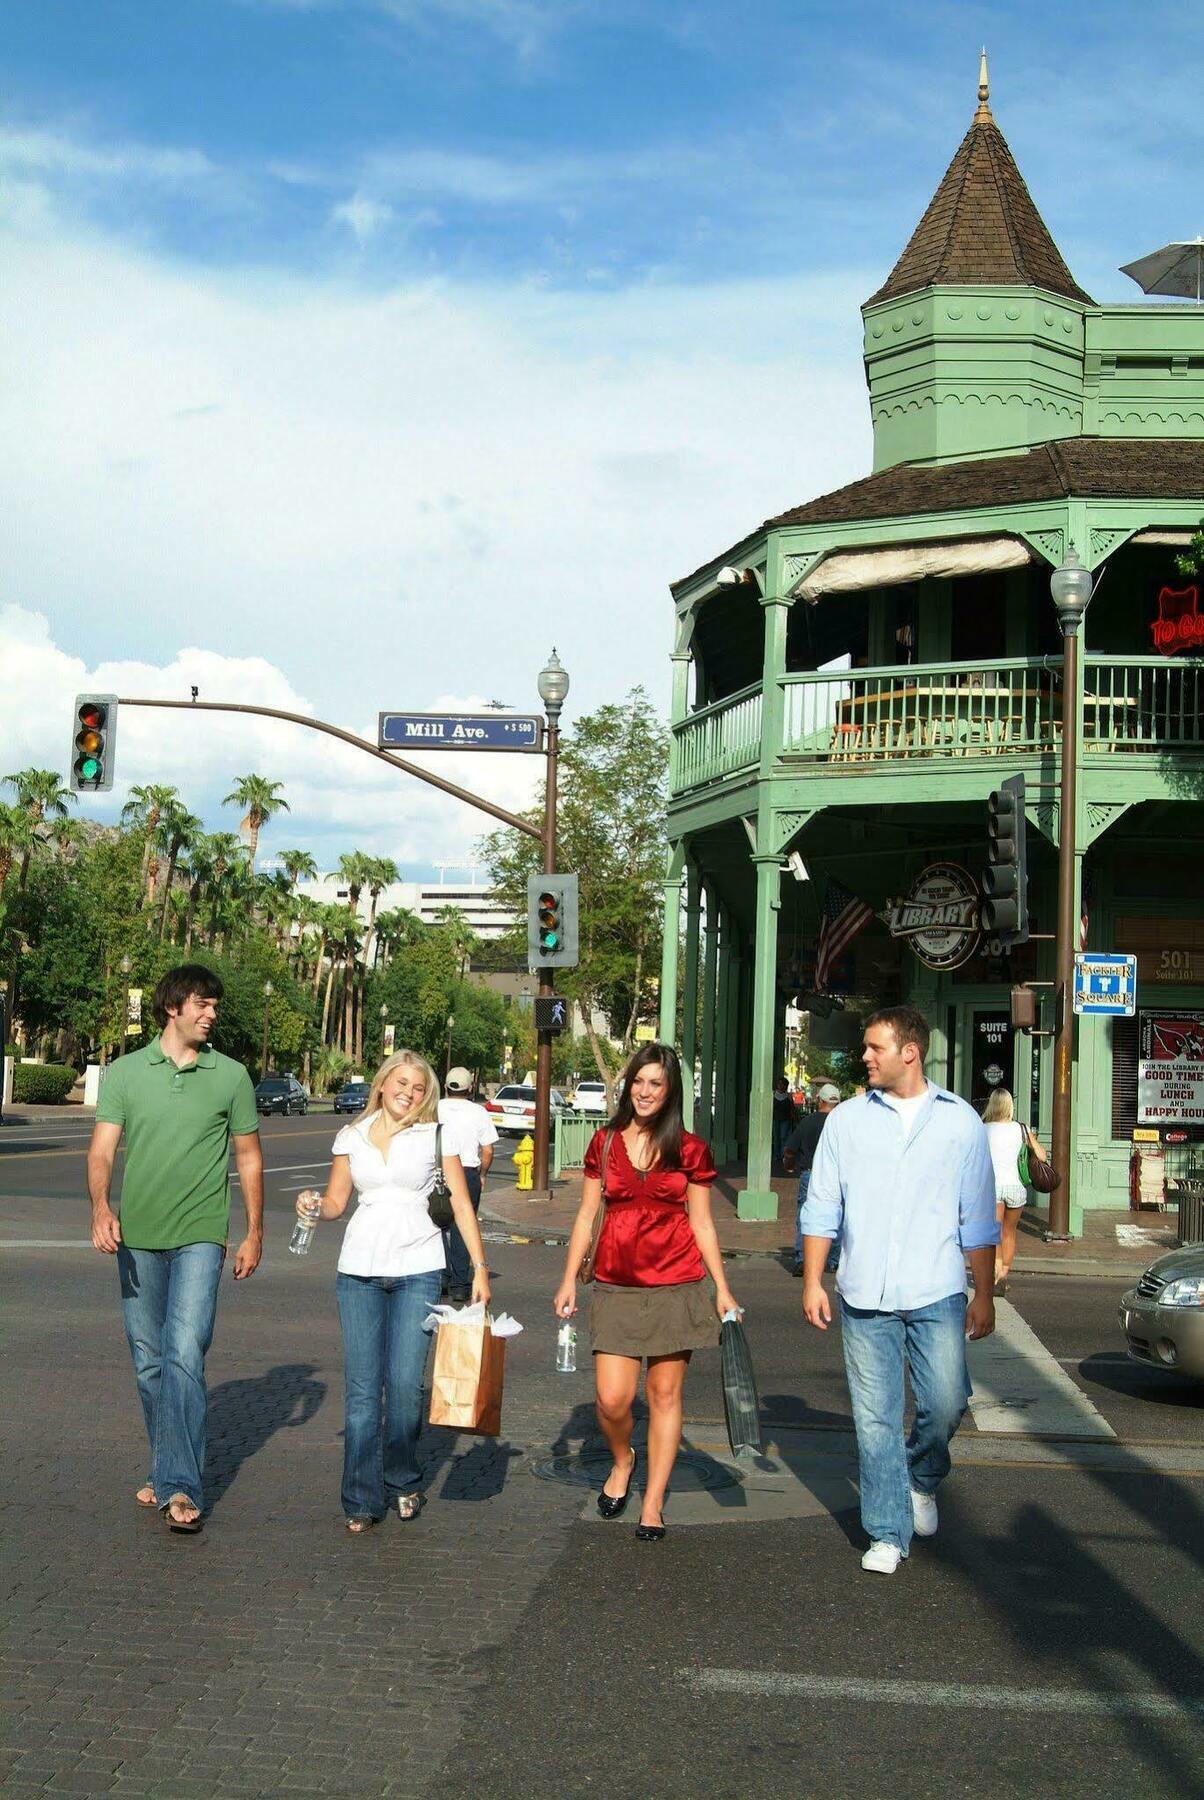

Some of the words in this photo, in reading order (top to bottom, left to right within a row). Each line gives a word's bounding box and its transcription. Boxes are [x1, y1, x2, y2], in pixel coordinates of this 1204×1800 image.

[1151, 620, 1175, 646] TO
[405, 723, 444, 737] Mill
[452, 724, 489, 738] Ave.
[511, 724, 516, 732] S
[519, 724, 532, 732] 500
[889, 901, 972, 930] LIBRARY
[1160, 950, 1190, 969] 501
[1076, 992, 1132, 1006] SQUARE
[980, 1022, 1008, 1032] SUITE
[987, 1034, 1002, 1043] 101
[1145, 1070, 1173, 1080] GOOD
[1164, 1082, 1191, 1090] DURING
[1160, 1089, 1194, 1100] LUNCH
[1145, 1107, 1178, 1117] HAPPY
[1181, 1108, 1204, 1118] HOU
